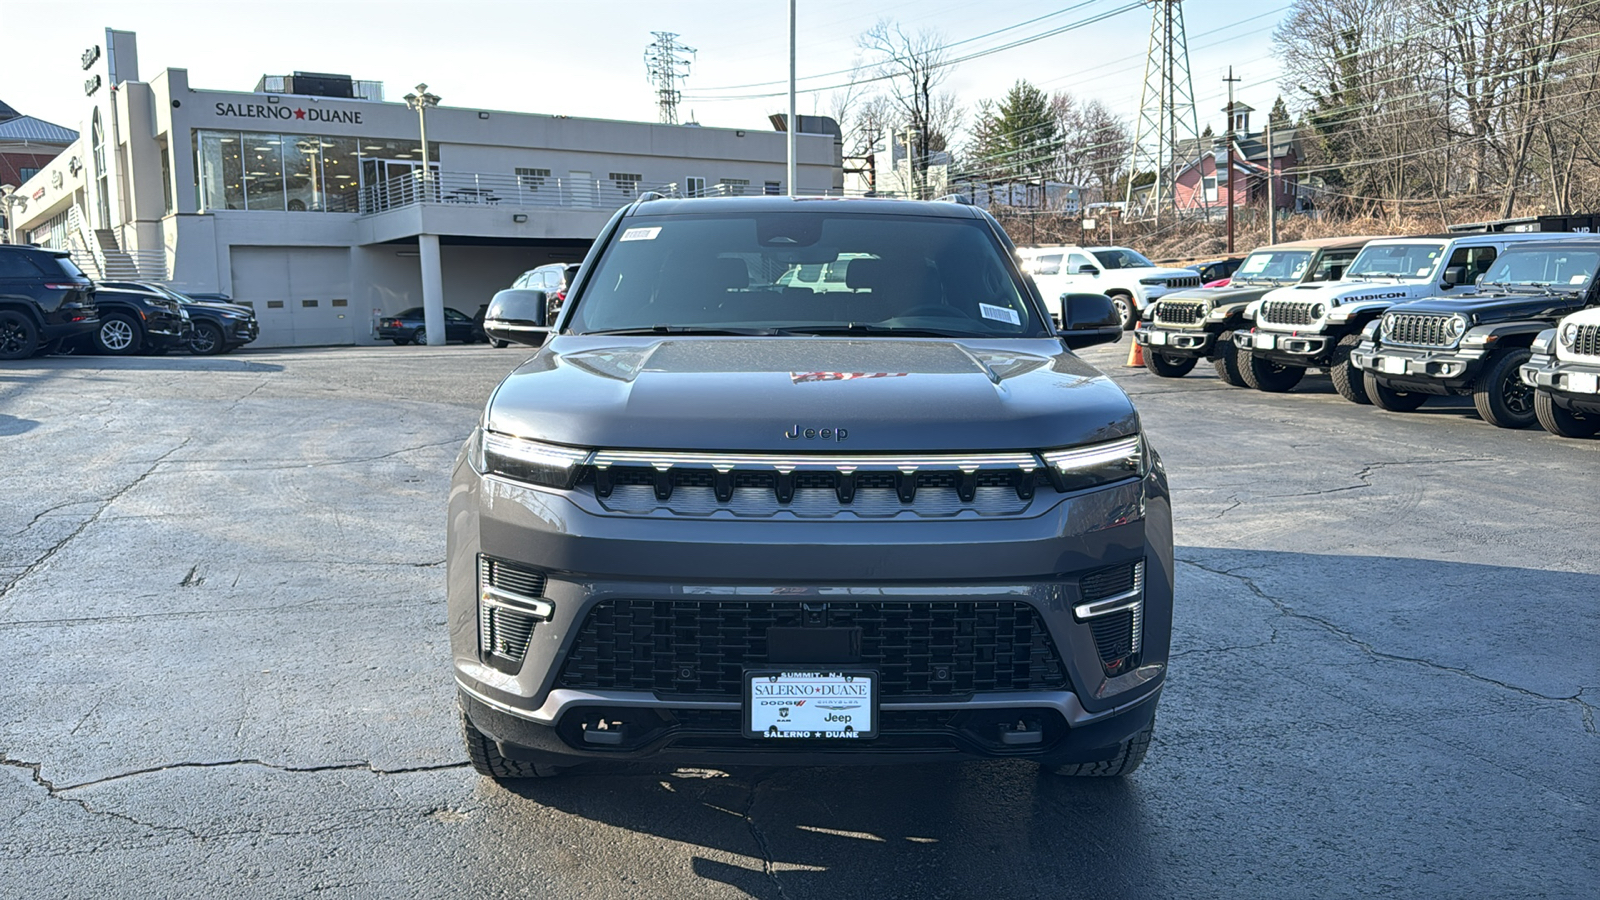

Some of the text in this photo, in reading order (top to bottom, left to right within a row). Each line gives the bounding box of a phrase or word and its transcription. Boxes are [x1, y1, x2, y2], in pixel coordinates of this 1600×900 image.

[216, 102, 363, 124] SALERNO DUANE
[1344, 292, 1406, 302] RUBICON
[785, 424, 849, 442] Jeep
[755, 685, 867, 696] SALERNO DUANE
[824, 712, 852, 724] Jeep
